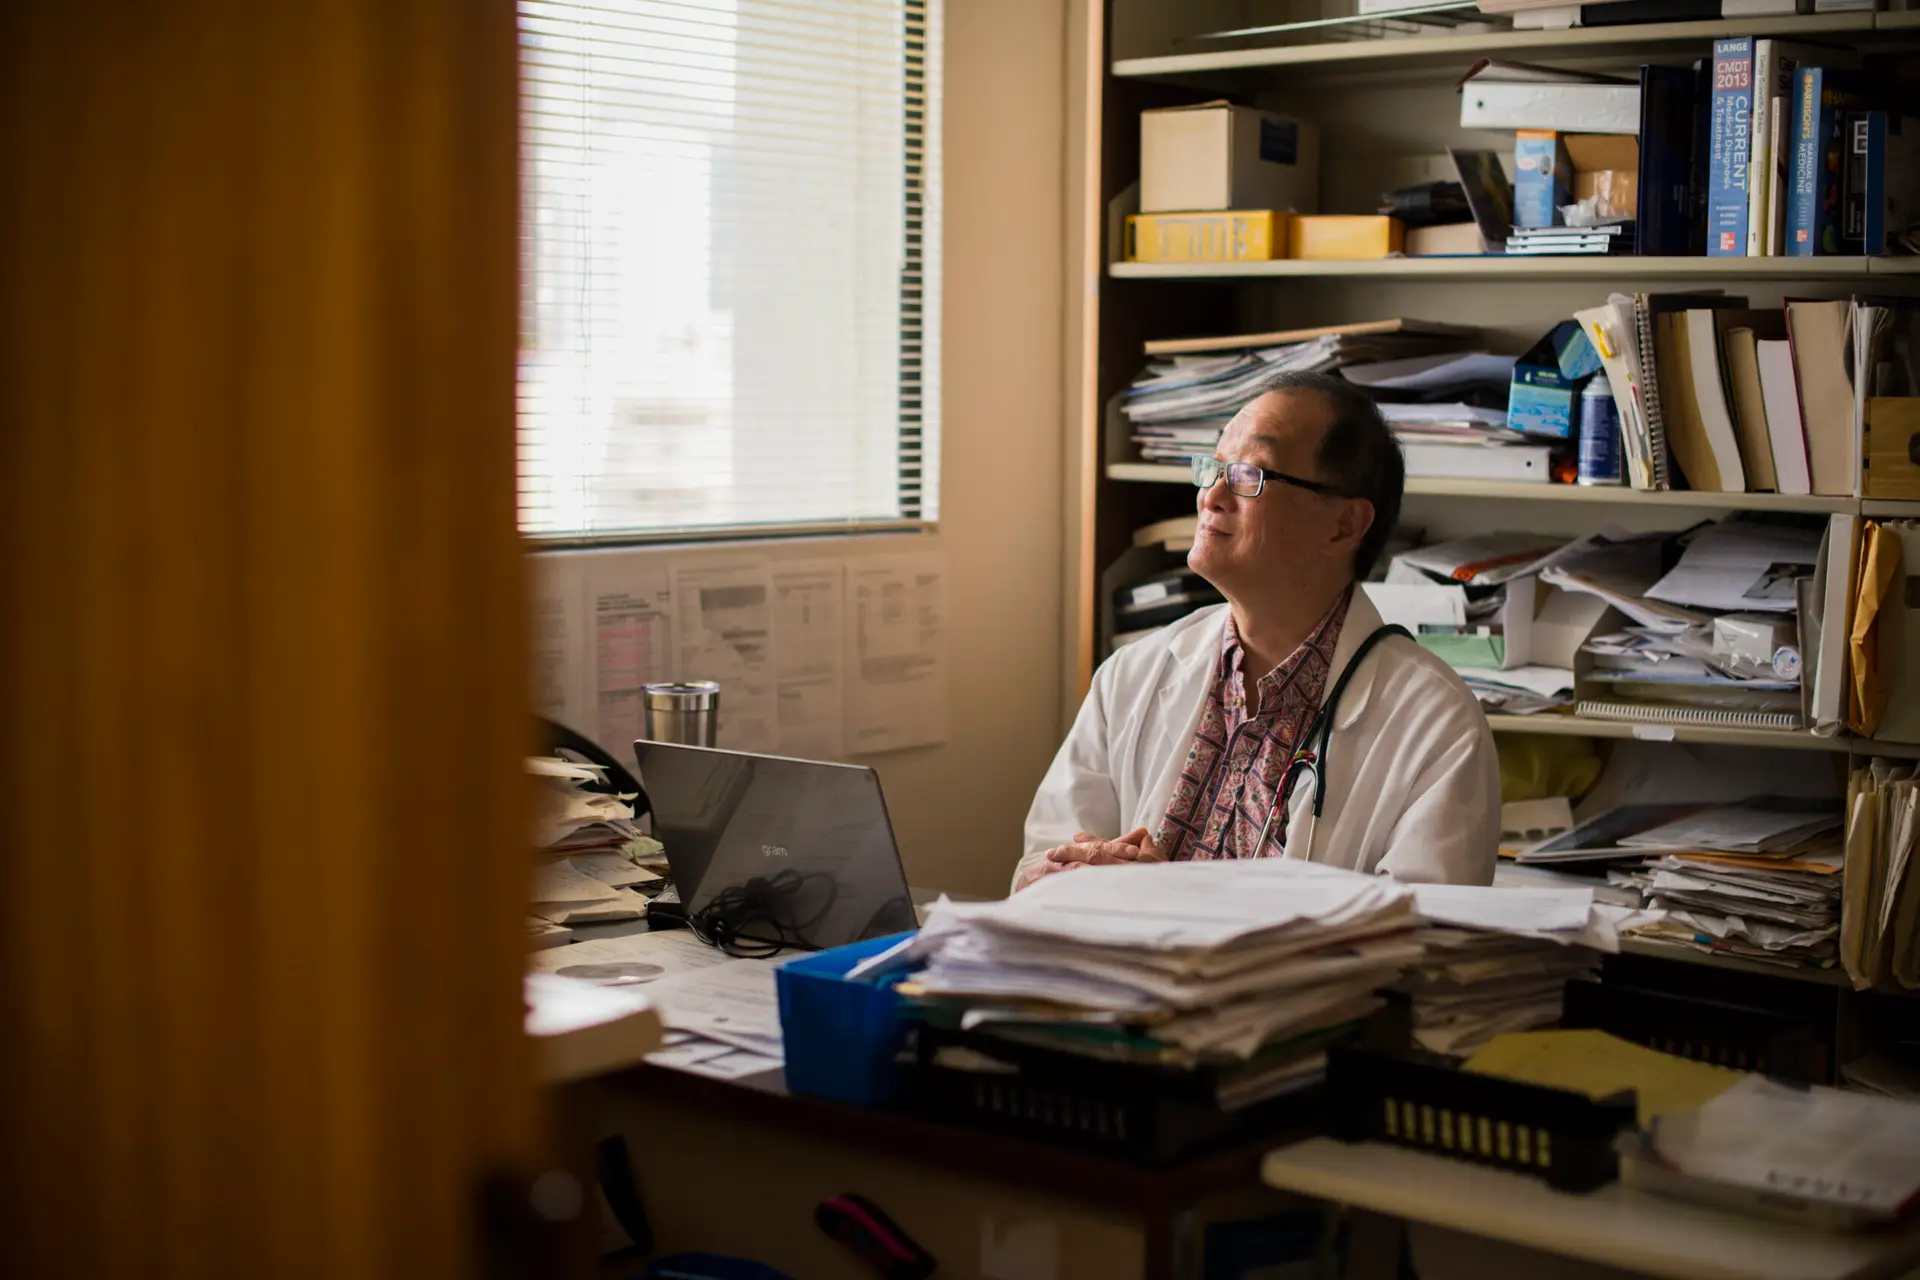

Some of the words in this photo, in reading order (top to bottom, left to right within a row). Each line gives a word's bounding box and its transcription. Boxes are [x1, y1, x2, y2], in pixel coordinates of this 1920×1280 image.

[1717, 42, 1749, 54] LANGE
[1716, 61, 1749, 74] CMDT
[1717, 72, 1748, 88] 2013
[1716, 96, 1725, 105] &
[1725, 95, 1734, 137] Medical
[1802, 83, 1813, 140] HARRISON'S
[1714, 107, 1724, 160] Treatment
[1733, 95, 1748, 190] CURRENT
[1723, 139, 1733, 190] Diagnosis
[1796, 142, 1807, 195] MEDICINE
[1805, 142, 1814, 180] MANUAL
[1805, 181, 1812, 194] OF
[761, 844, 788, 857] gram
